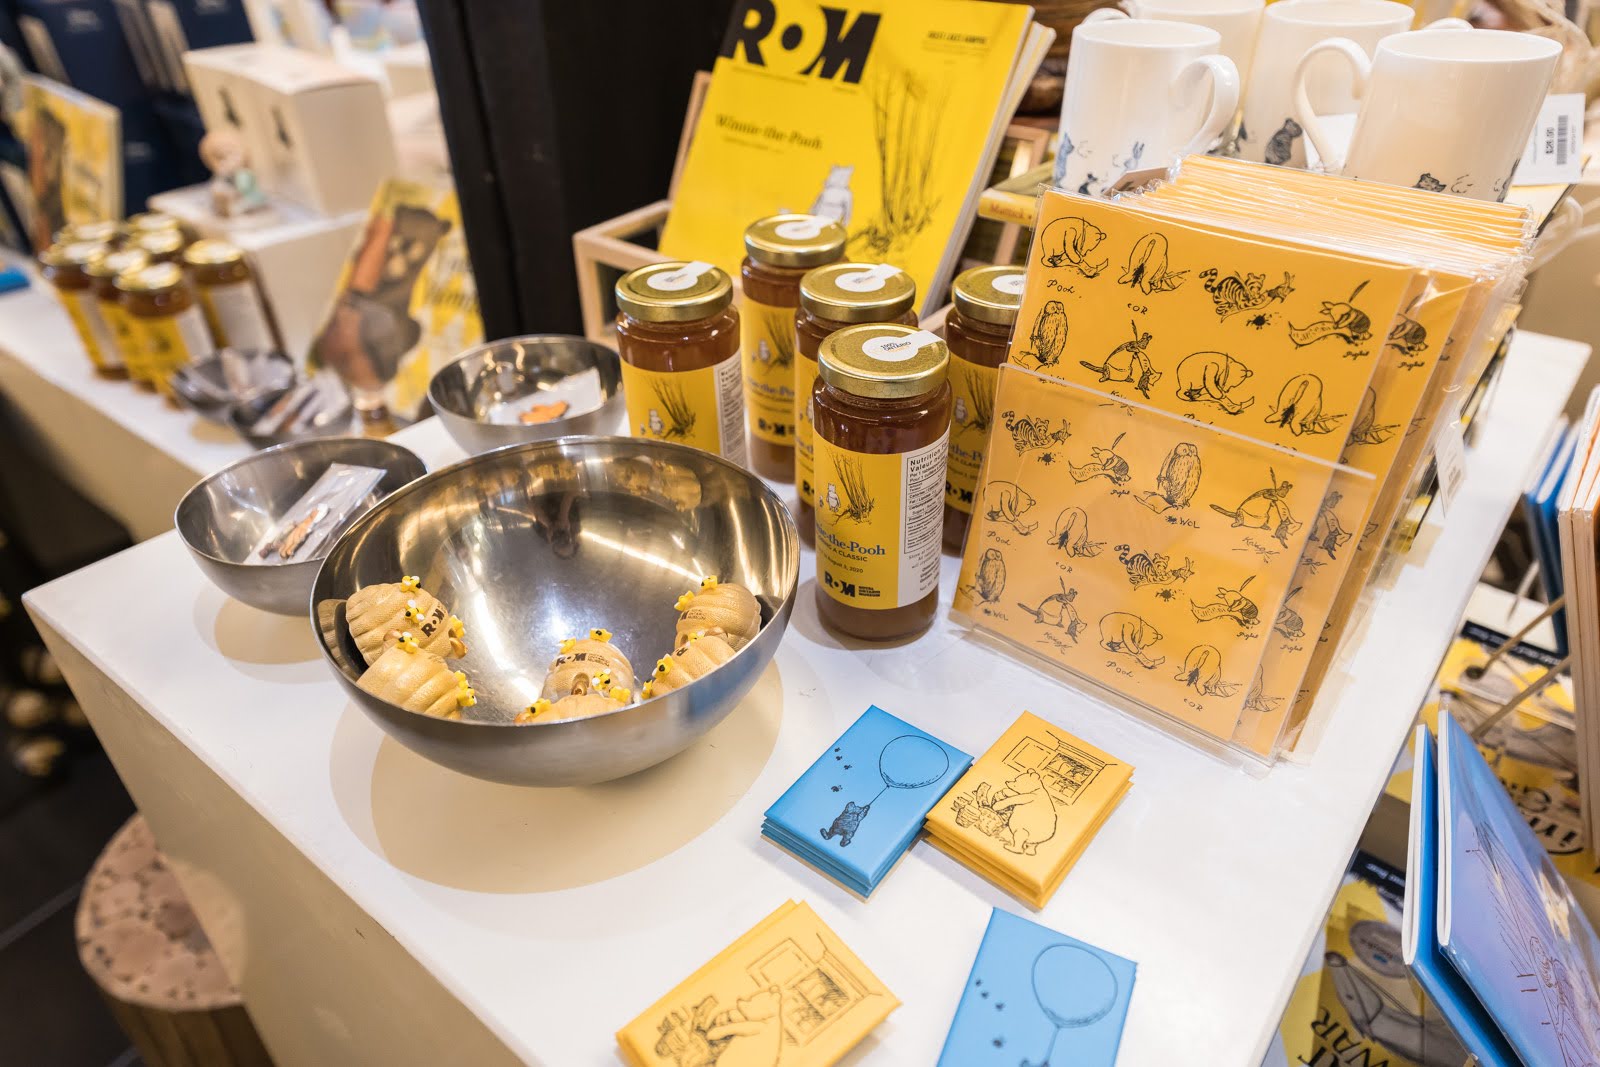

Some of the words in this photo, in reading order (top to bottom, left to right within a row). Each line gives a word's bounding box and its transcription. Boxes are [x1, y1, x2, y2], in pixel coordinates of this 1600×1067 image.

[719, 0, 881, 84] ROM
[910, 448, 940, 467] Nutrition
[910, 459, 933, 473] Valeur
[838, 550, 868, 562] CLASSIC
[824, 570, 856, 598] ROM
